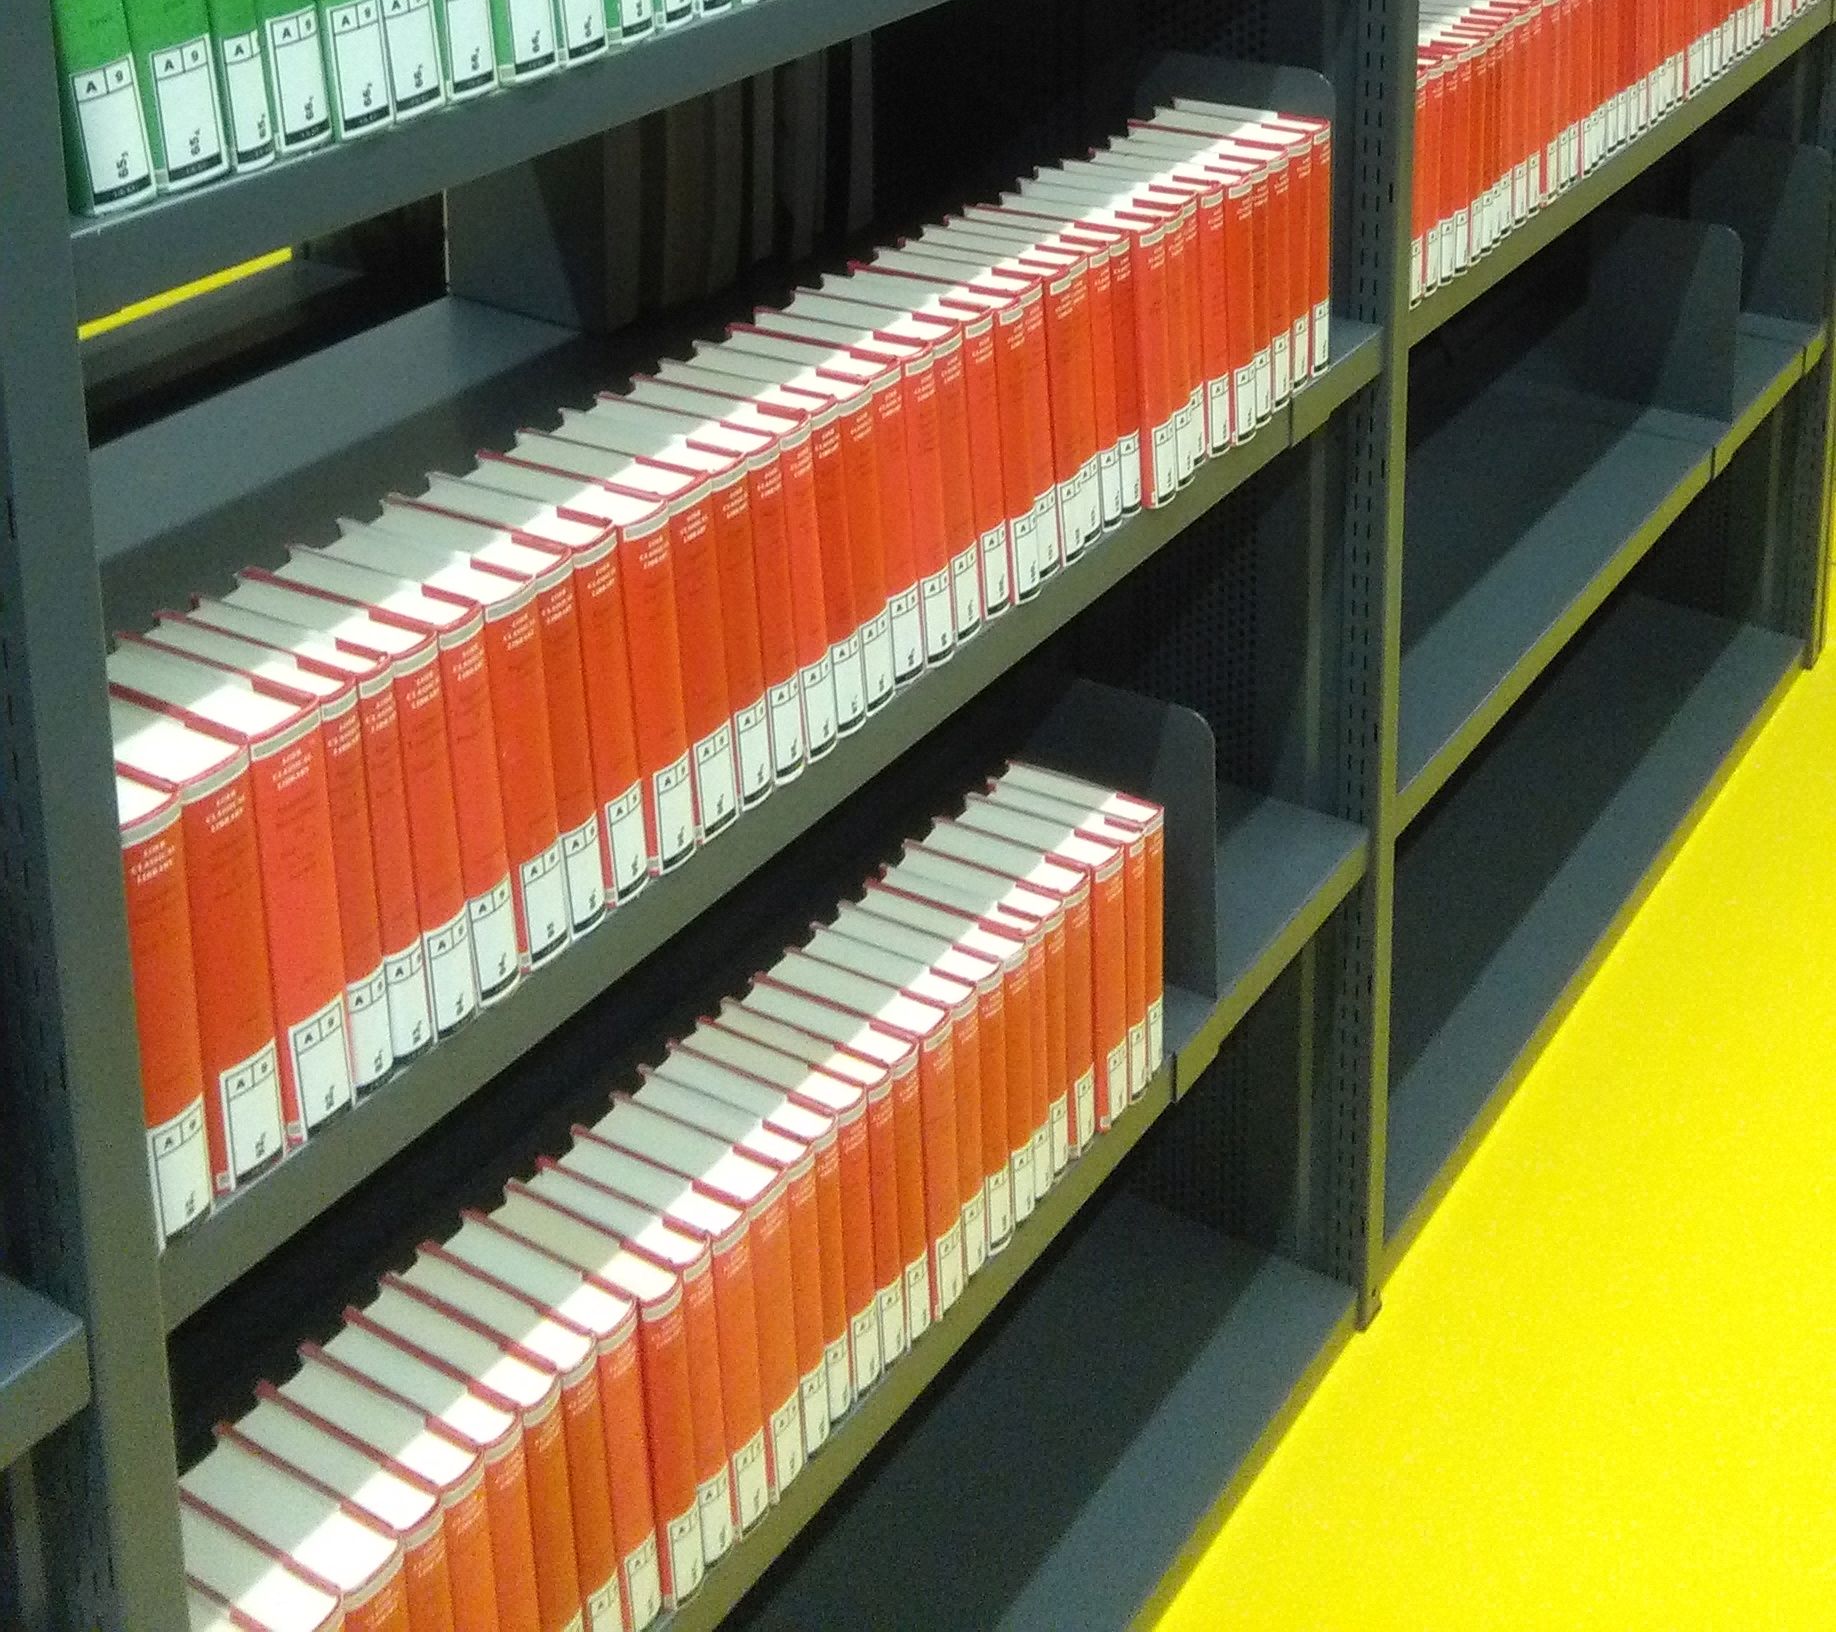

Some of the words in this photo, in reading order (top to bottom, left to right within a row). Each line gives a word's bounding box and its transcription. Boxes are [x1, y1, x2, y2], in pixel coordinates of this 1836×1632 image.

[391, 0, 401, 11] A
[341, 15, 350, 27] A
[282, 27, 292, 39] A
[234, 44, 244, 56] A
[164, 59, 174, 72] A
[86, 81, 97, 94] A
